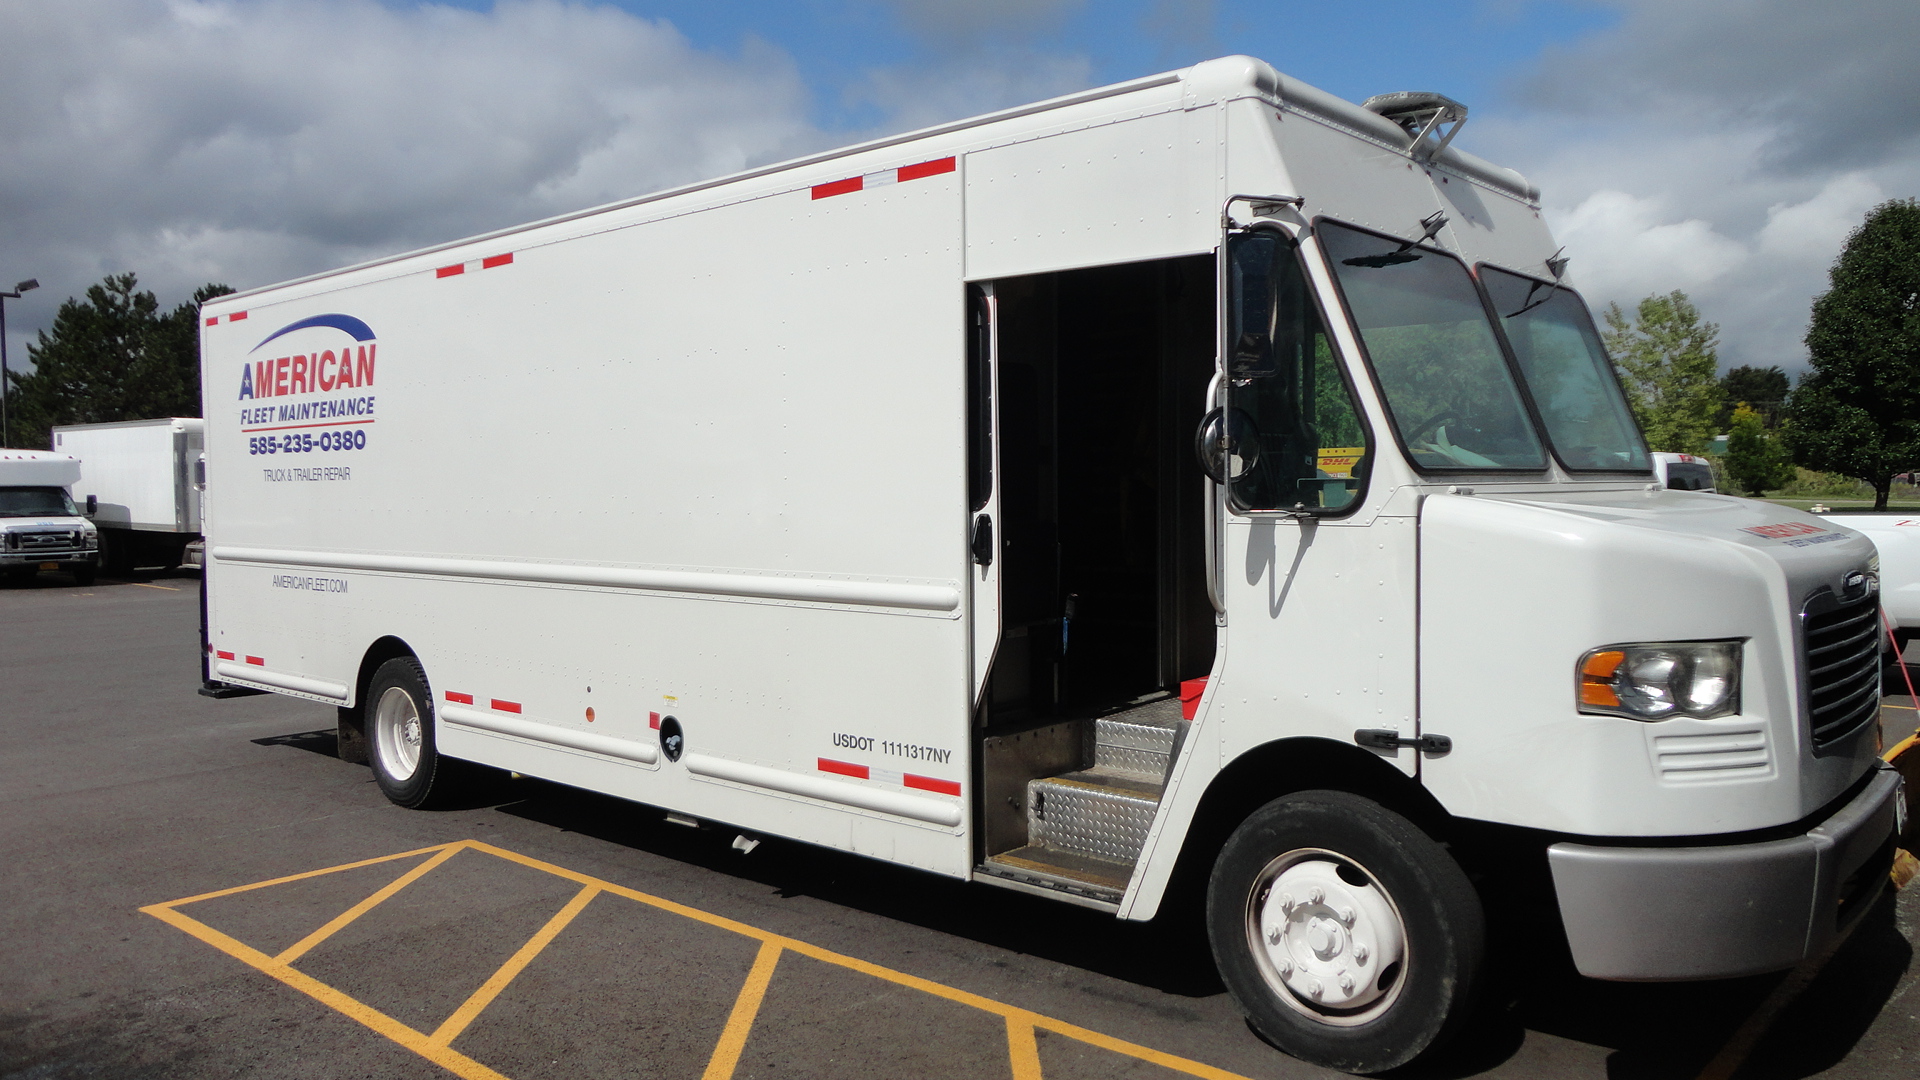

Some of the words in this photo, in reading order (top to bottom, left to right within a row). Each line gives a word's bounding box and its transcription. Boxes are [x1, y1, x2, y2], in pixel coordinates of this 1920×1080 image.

[238, 343, 377, 401] AMERICAN
[240, 406, 275, 425] FLEET
[278, 396, 375, 421] MAINTENANCE
[249, 429, 366, 455] 585-235-0380
[263, 468, 286, 482] TRUCK
[287, 468, 292, 481] &
[293, 467, 322, 481] TRAILER
[324, 466, 351, 481] REPAIR
[1322, 458, 1351, 466] DHL
[272, 574, 348, 593] AMERICANFLEET.COM
[833, 732, 875, 752] USDOT
[881, 740, 951, 764] 1111317NY
